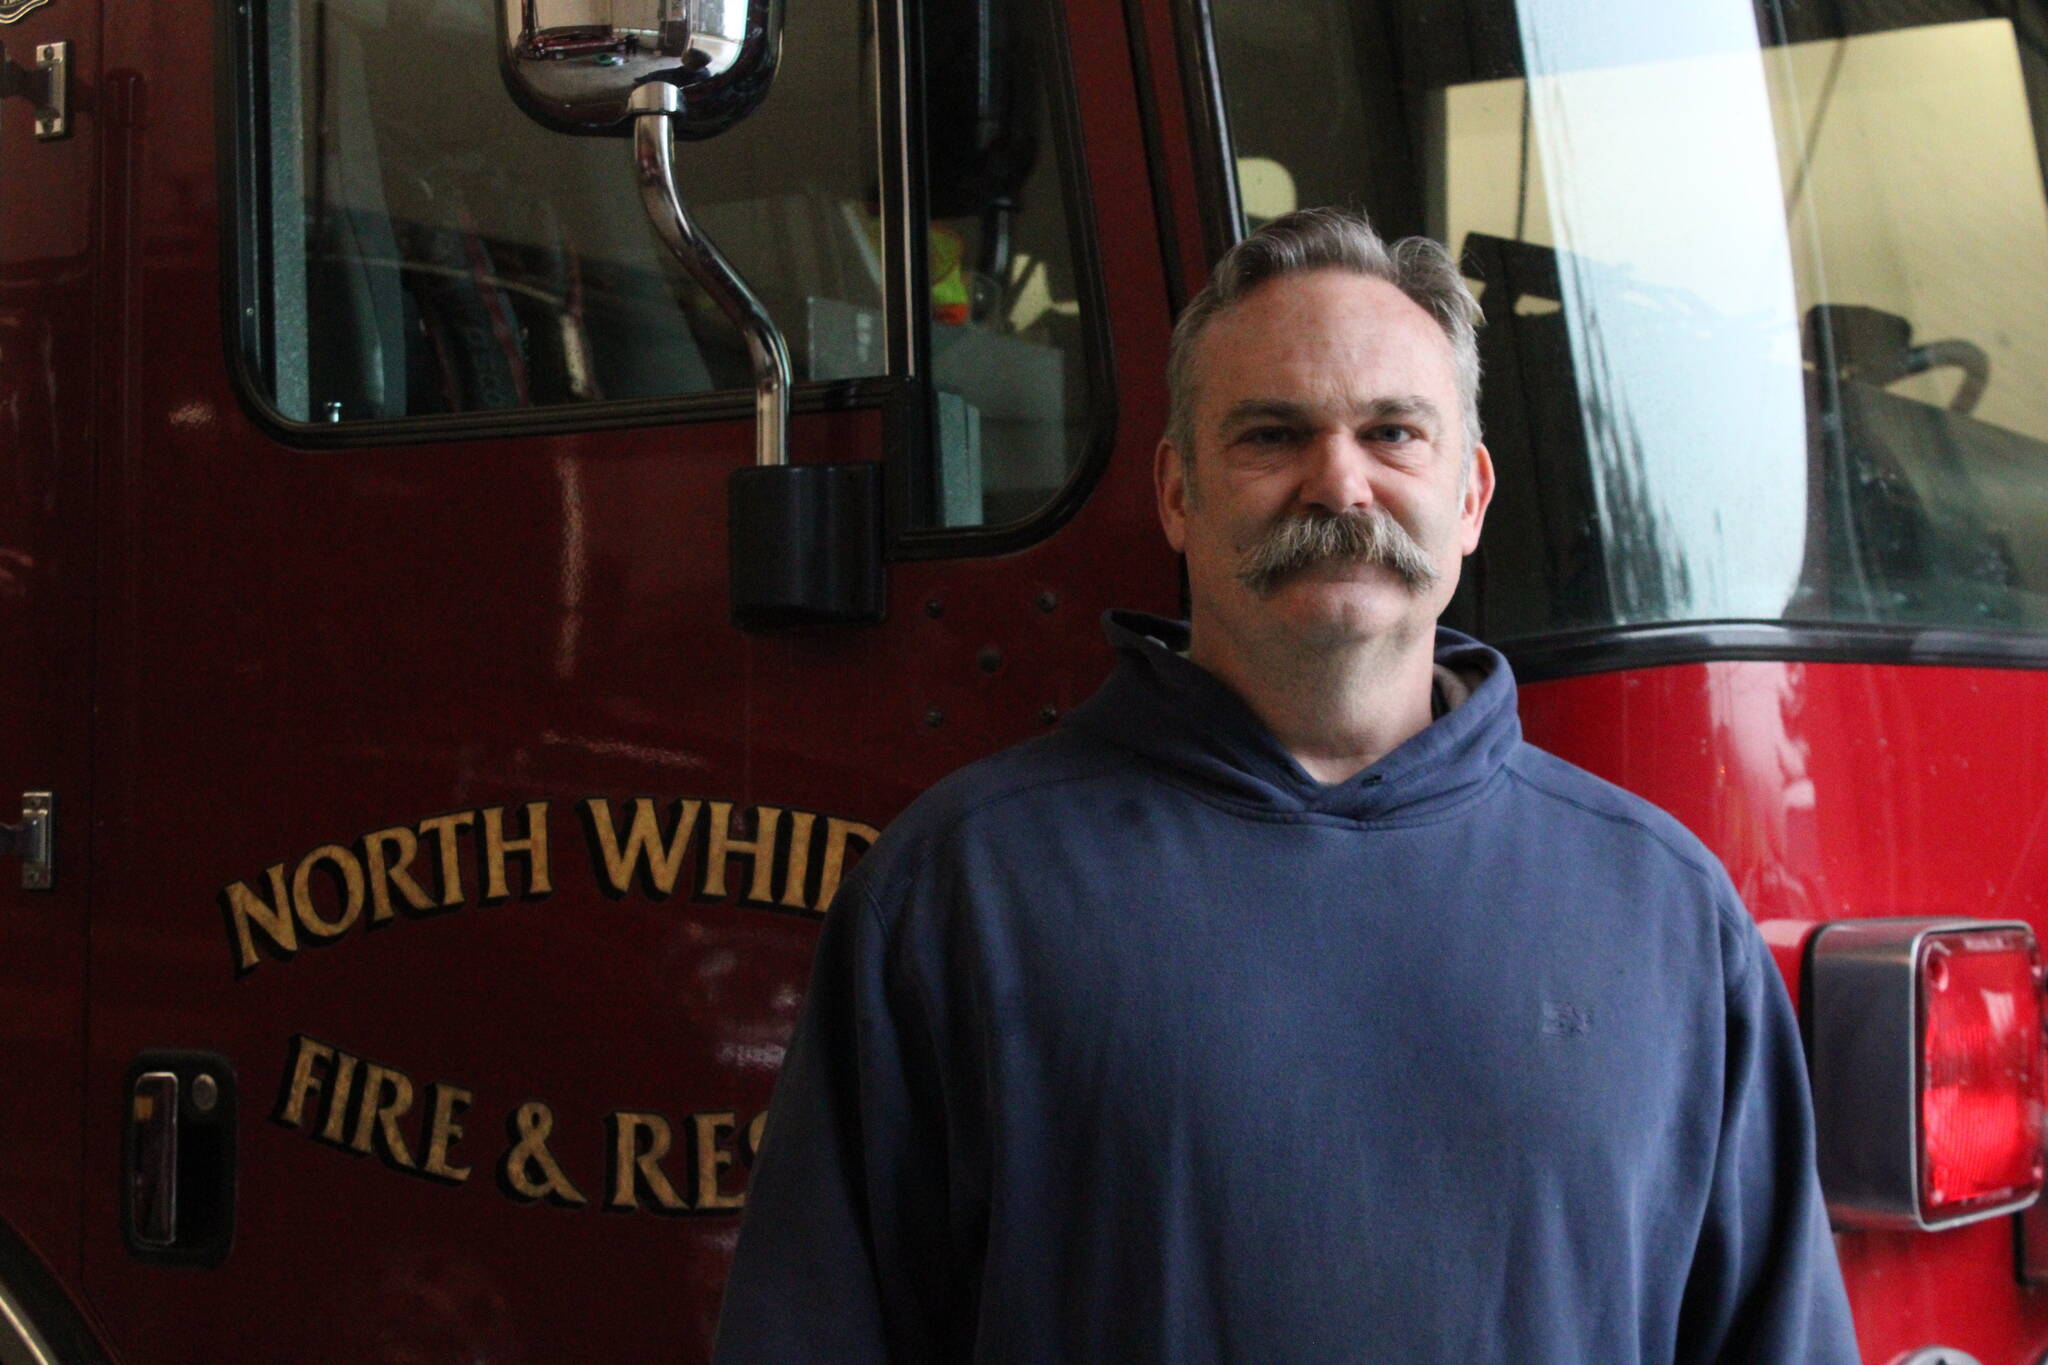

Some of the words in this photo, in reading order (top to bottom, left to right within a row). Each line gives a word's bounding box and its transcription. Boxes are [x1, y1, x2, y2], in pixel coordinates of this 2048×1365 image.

[221, 801, 552, 972] NORTH
[276, 1033, 474, 1184] FIRE
[504, 1101, 588, 1204] &
